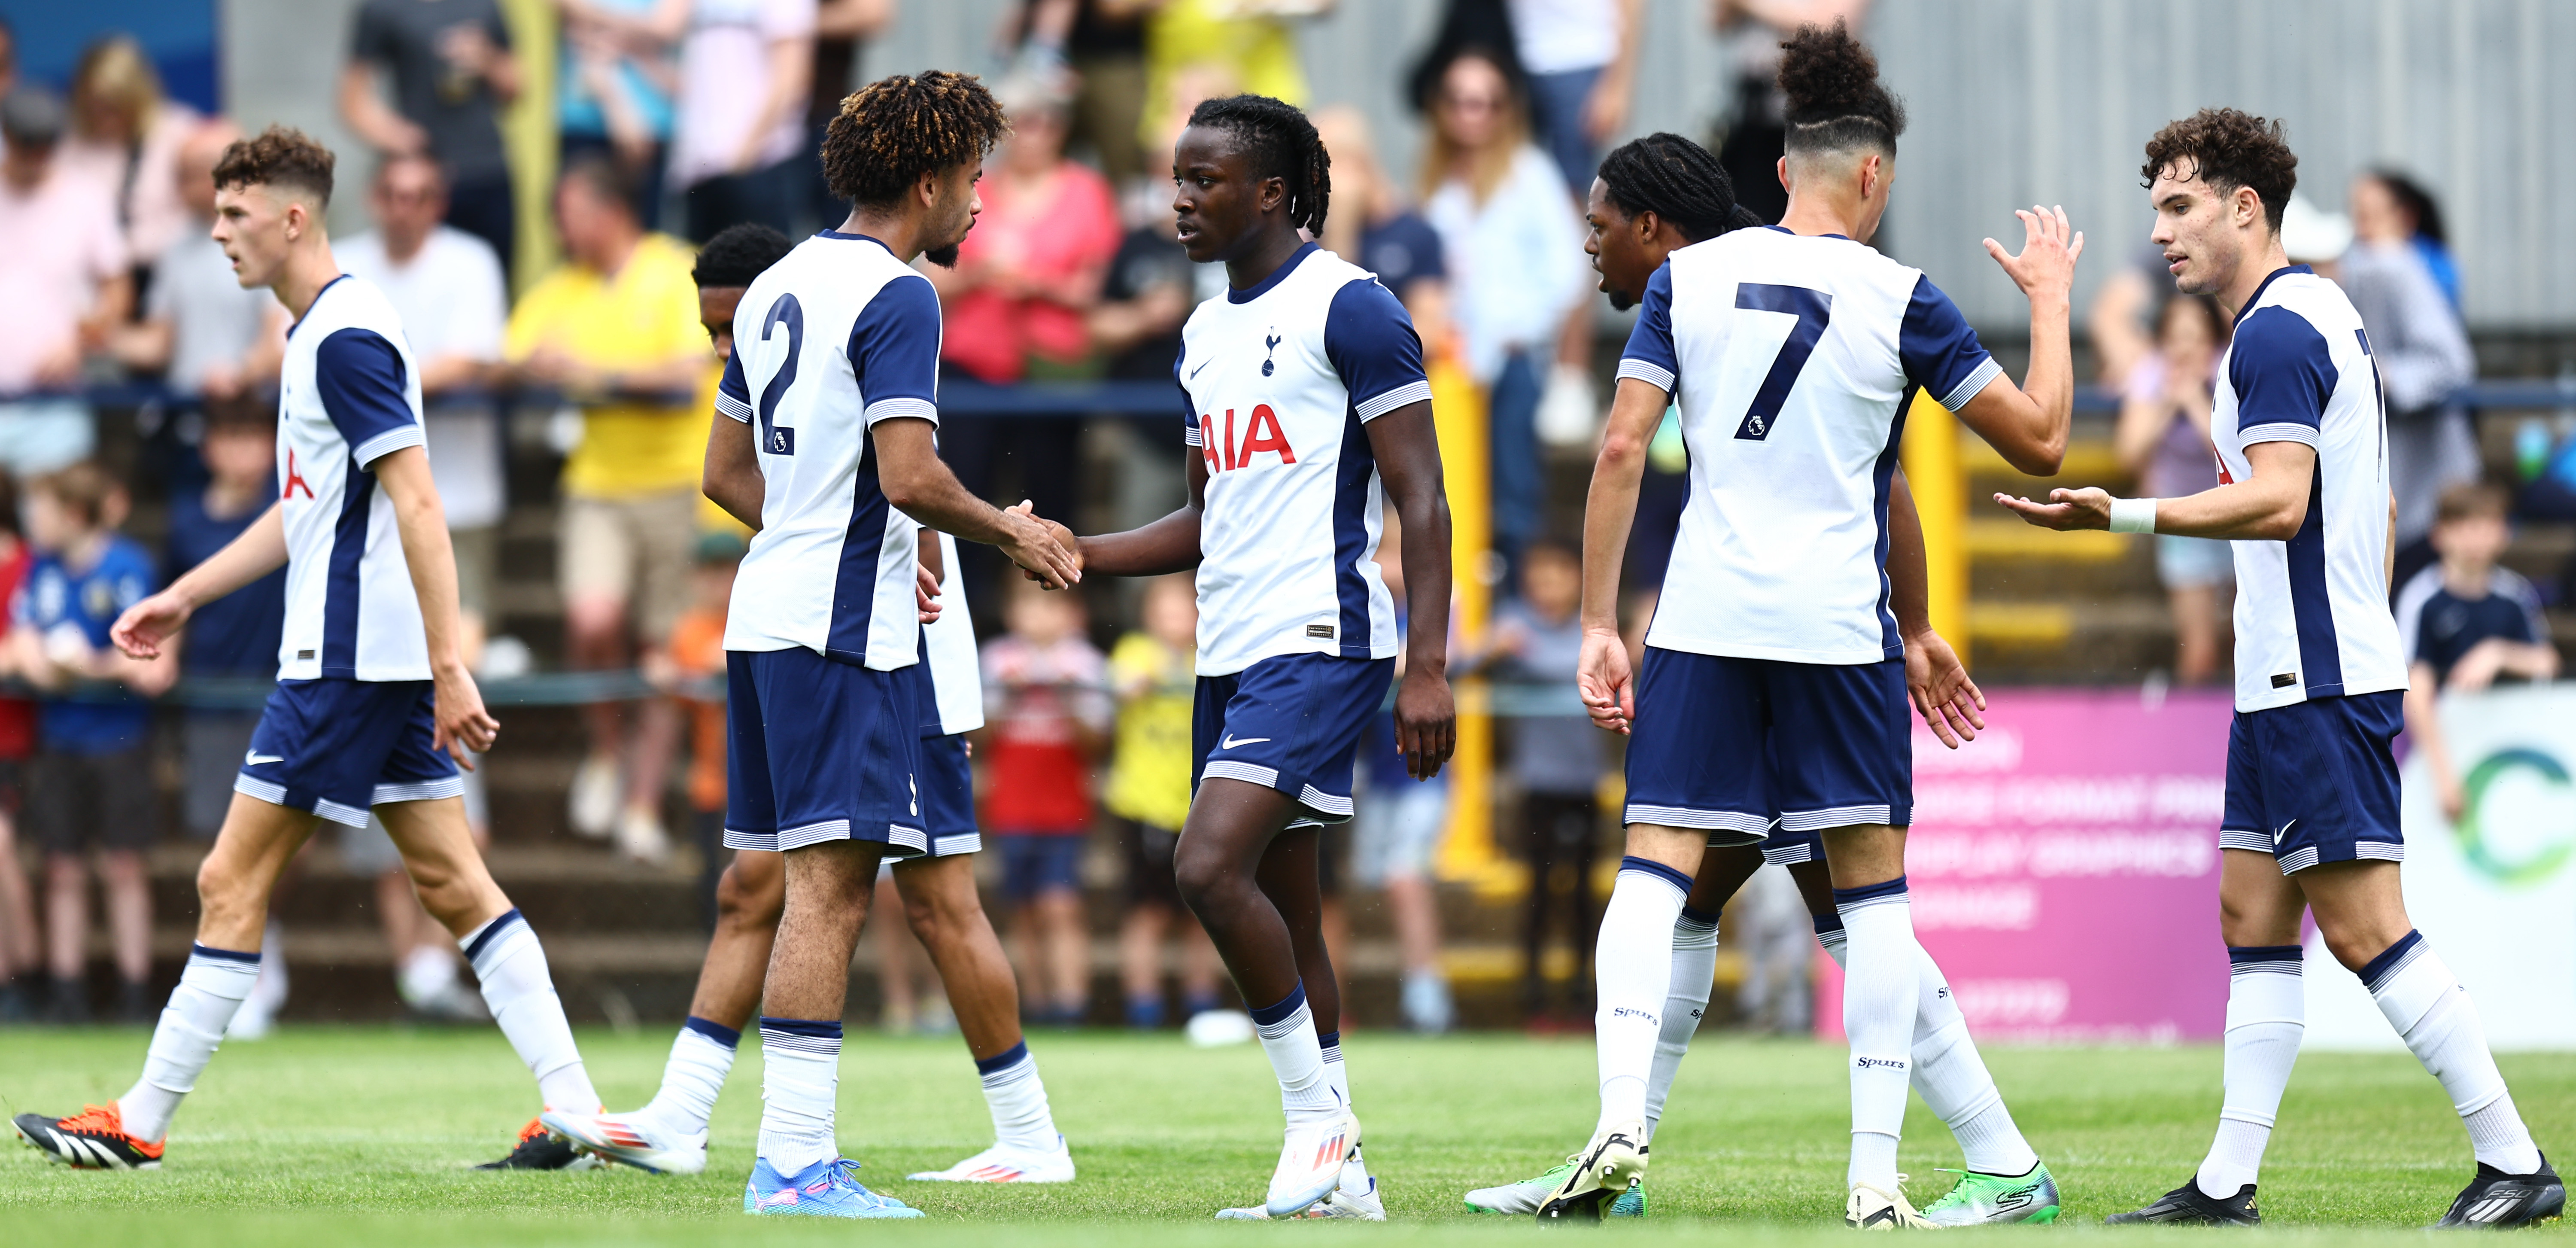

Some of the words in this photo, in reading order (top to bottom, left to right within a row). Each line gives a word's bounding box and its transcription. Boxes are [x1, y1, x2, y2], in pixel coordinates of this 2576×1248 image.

[1733, 282, 1833, 441] 7
[759, 292, 804, 456] 2
[1201, 403, 1297, 474] AIA
[1614, 1007, 1658, 1026] Spurs
[1858, 1056, 1904, 1068] Spurs
[1322, 1122, 1348, 1139] F50
[2484, 1189, 2533, 1199] F50
